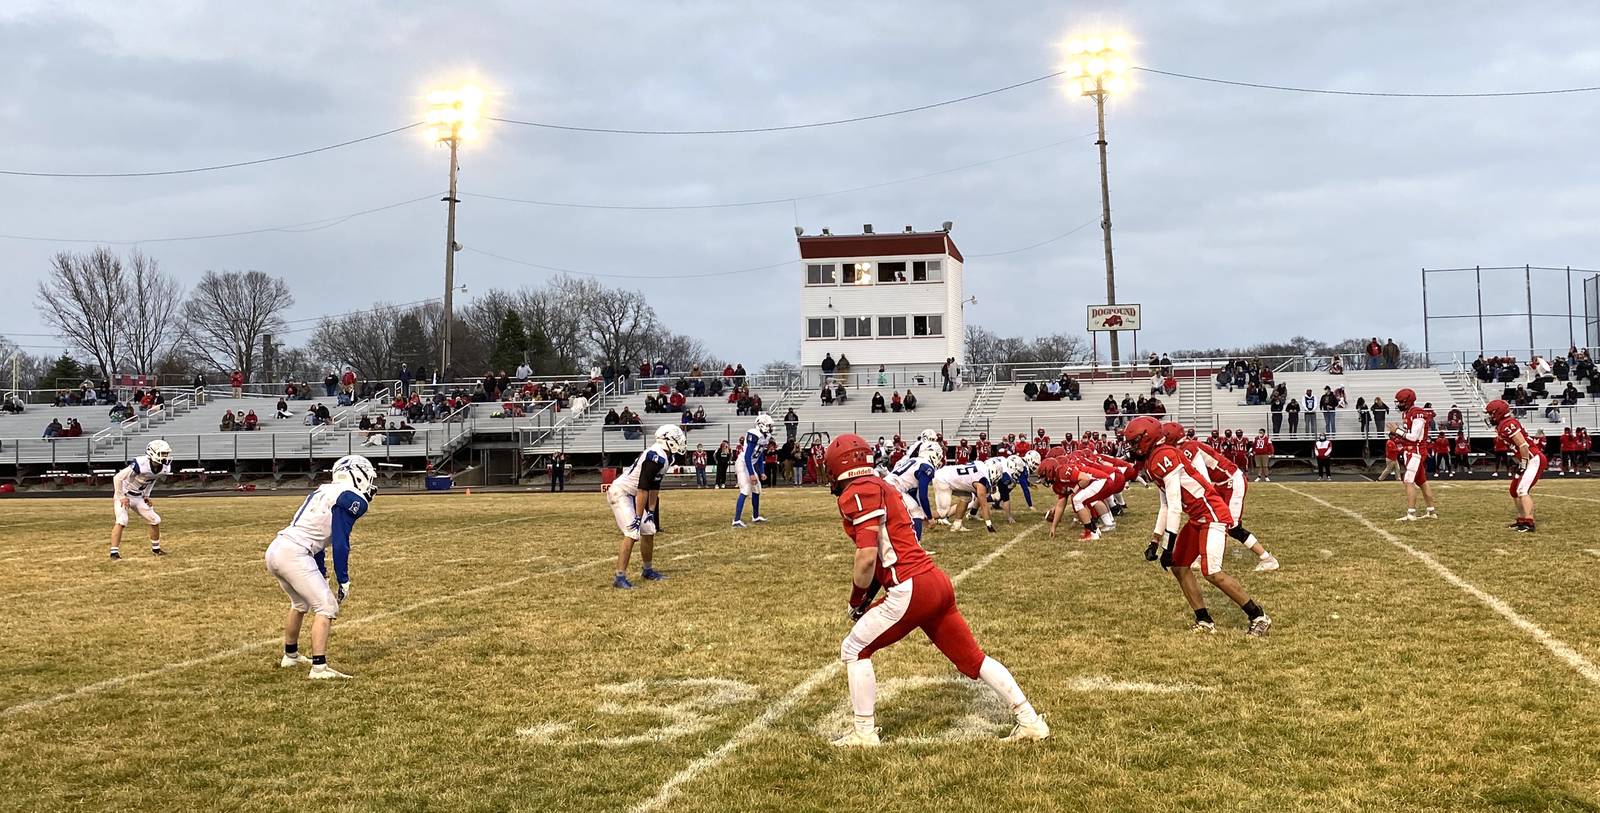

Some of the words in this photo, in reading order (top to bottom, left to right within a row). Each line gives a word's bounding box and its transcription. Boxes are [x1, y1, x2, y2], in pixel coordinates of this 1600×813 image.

[1092, 307, 1136, 318] DOGPOUND
[1505, 423, 1517, 435] 34
[1157, 456, 1173, 473] 14
[848, 469, 872, 478] Riddell
[854, 493, 863, 512] 1
